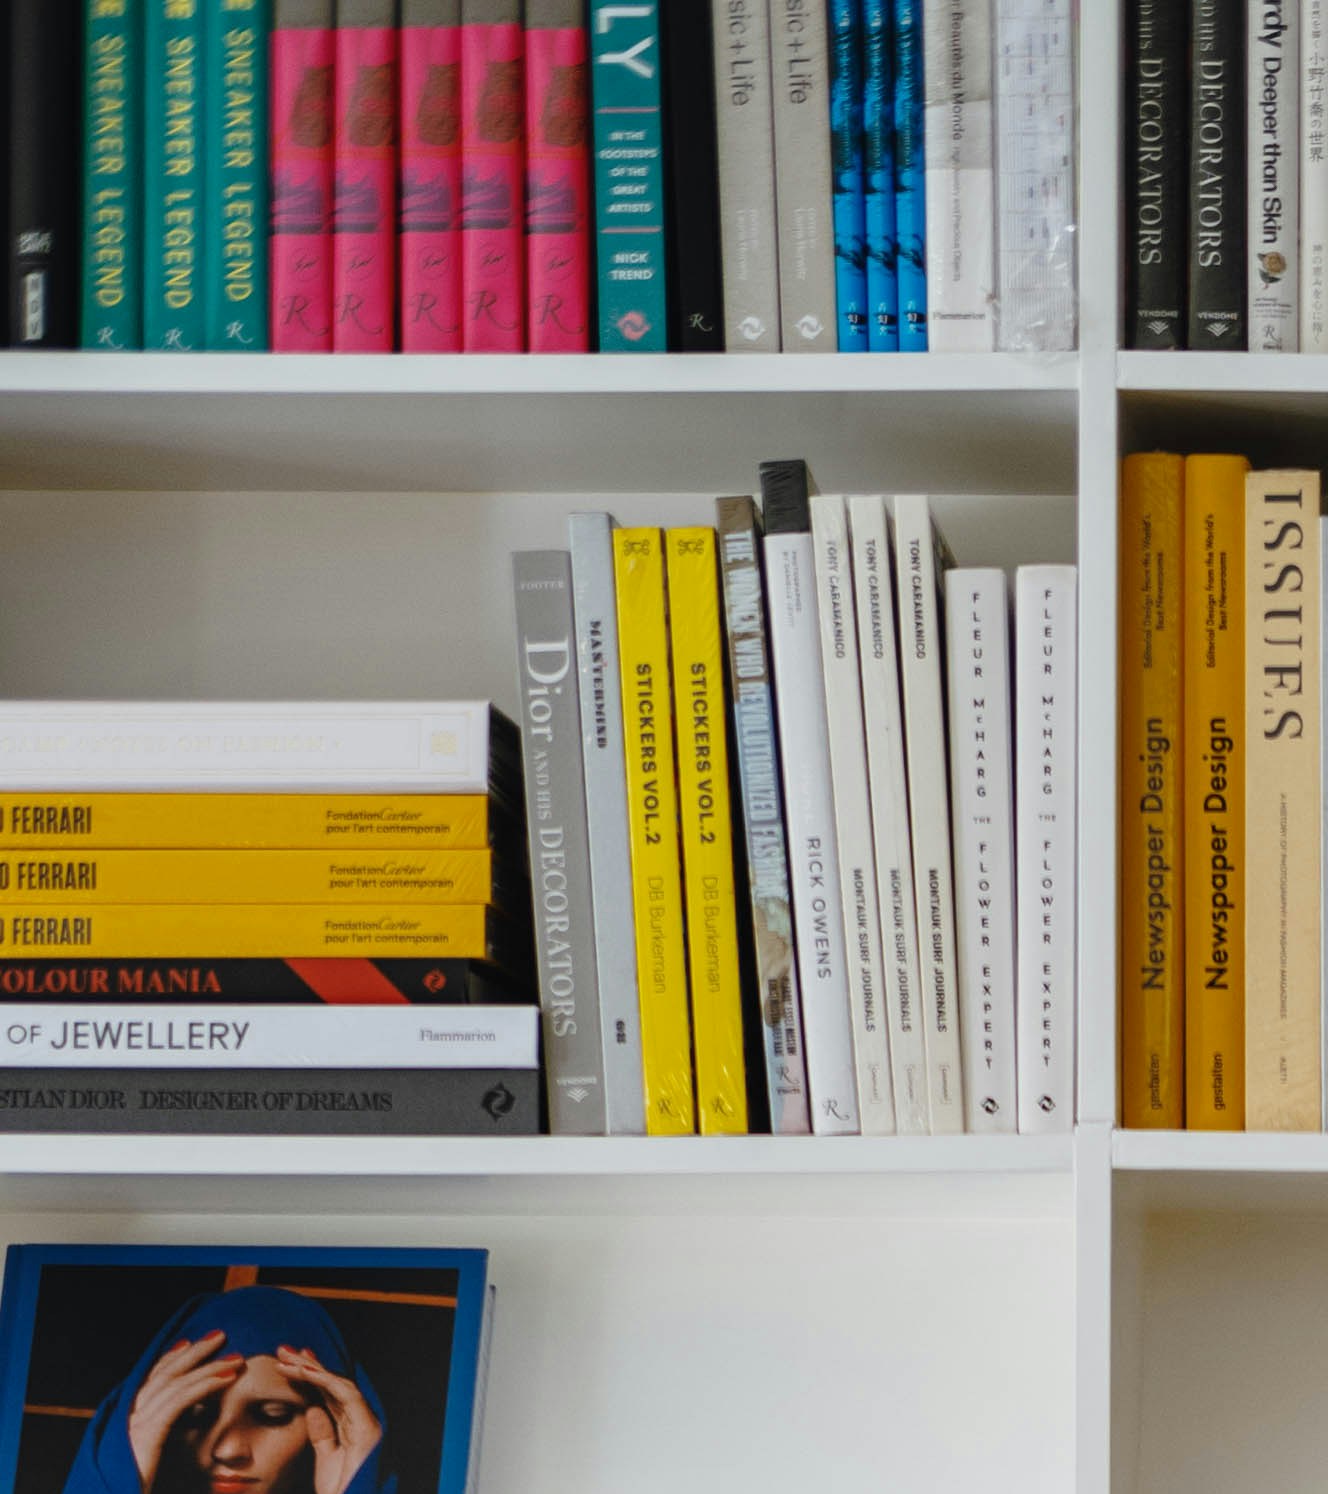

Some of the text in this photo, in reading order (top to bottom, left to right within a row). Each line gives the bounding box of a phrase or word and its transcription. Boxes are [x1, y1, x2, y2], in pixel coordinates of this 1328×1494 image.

[1264, 489, 1302, 741] ISSUES
[11, 805, 91, 835] FERRARI
[1203, 715, 1233, 991] Newspaper Design
[7, 1019, 249, 1051] OF JEWELLERY
